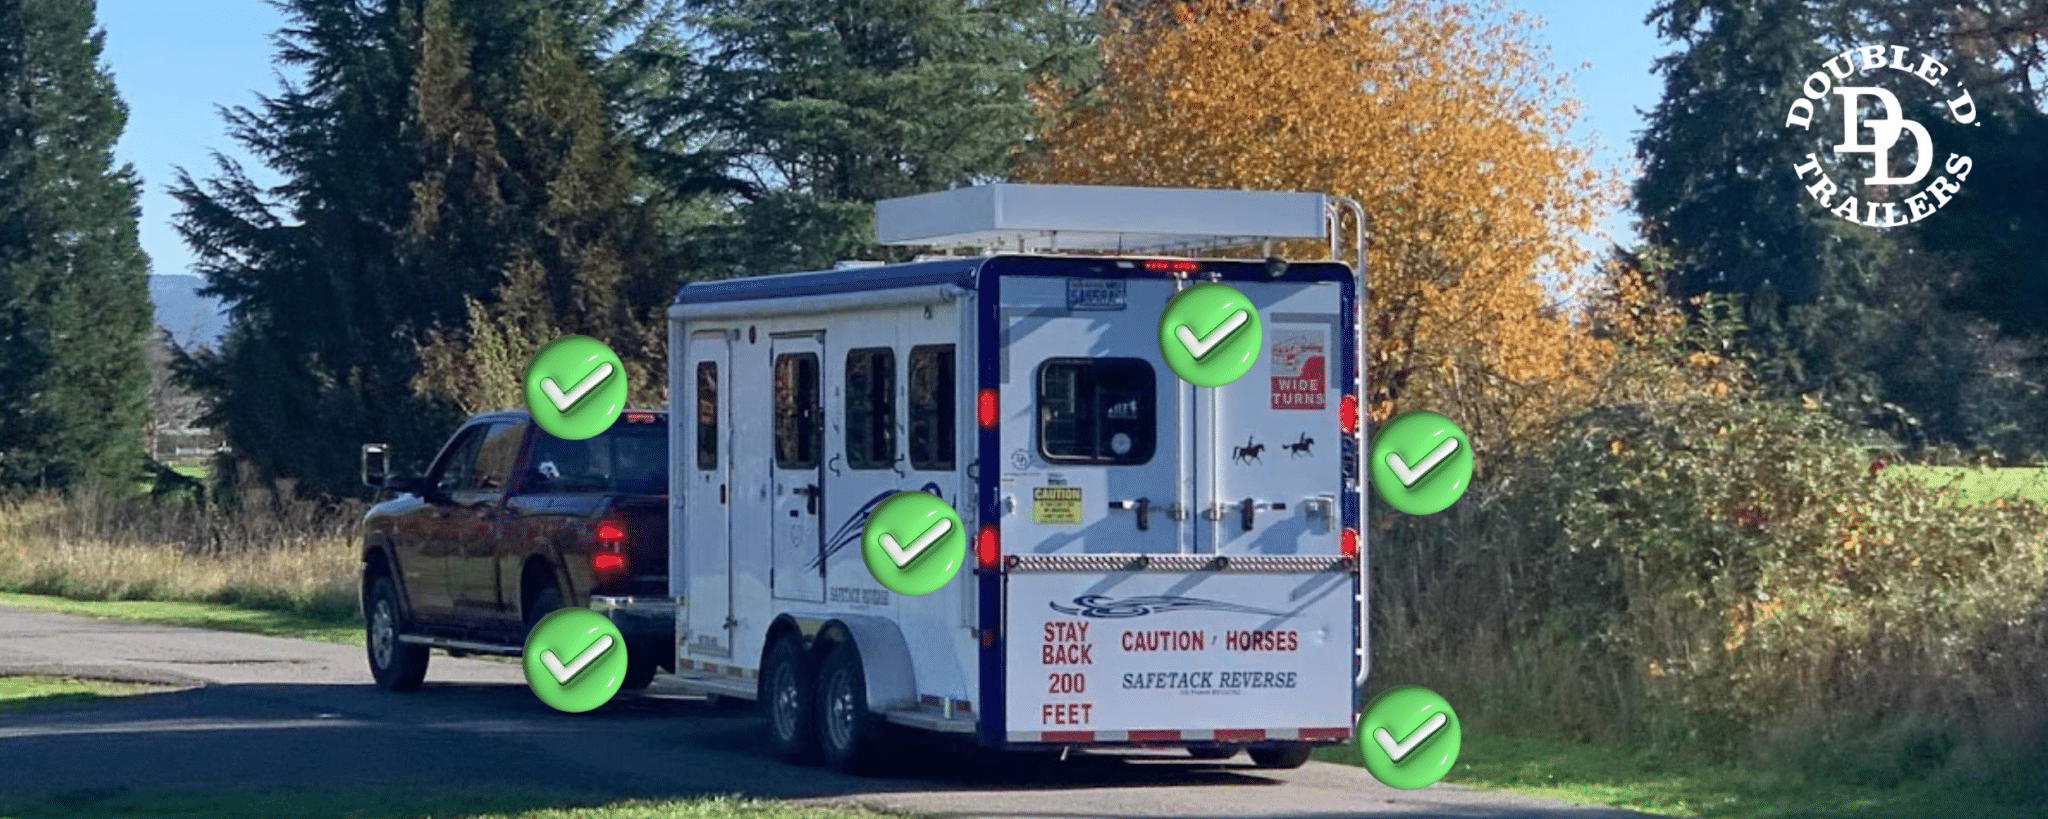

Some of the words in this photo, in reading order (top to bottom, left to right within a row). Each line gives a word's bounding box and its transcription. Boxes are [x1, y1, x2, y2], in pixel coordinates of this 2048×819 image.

[1278, 378, 1319, 392] WIDE
[1273, 393, 1324, 406] TURNS
[1034, 488, 1081, 500] CAUTION
[1044, 621, 1089, 642] STAY
[1121, 630, 1204, 651] CAUTION
[1226, 630, 1298, 651] HORSES
[1042, 644, 1092, 665] BACK
[1048, 673, 1085, 693] 200
[1122, 671, 1213, 689] SAFETACK
[1219, 671, 1297, 689] REVERSE
[1042, 703, 1092, 725] FEET
